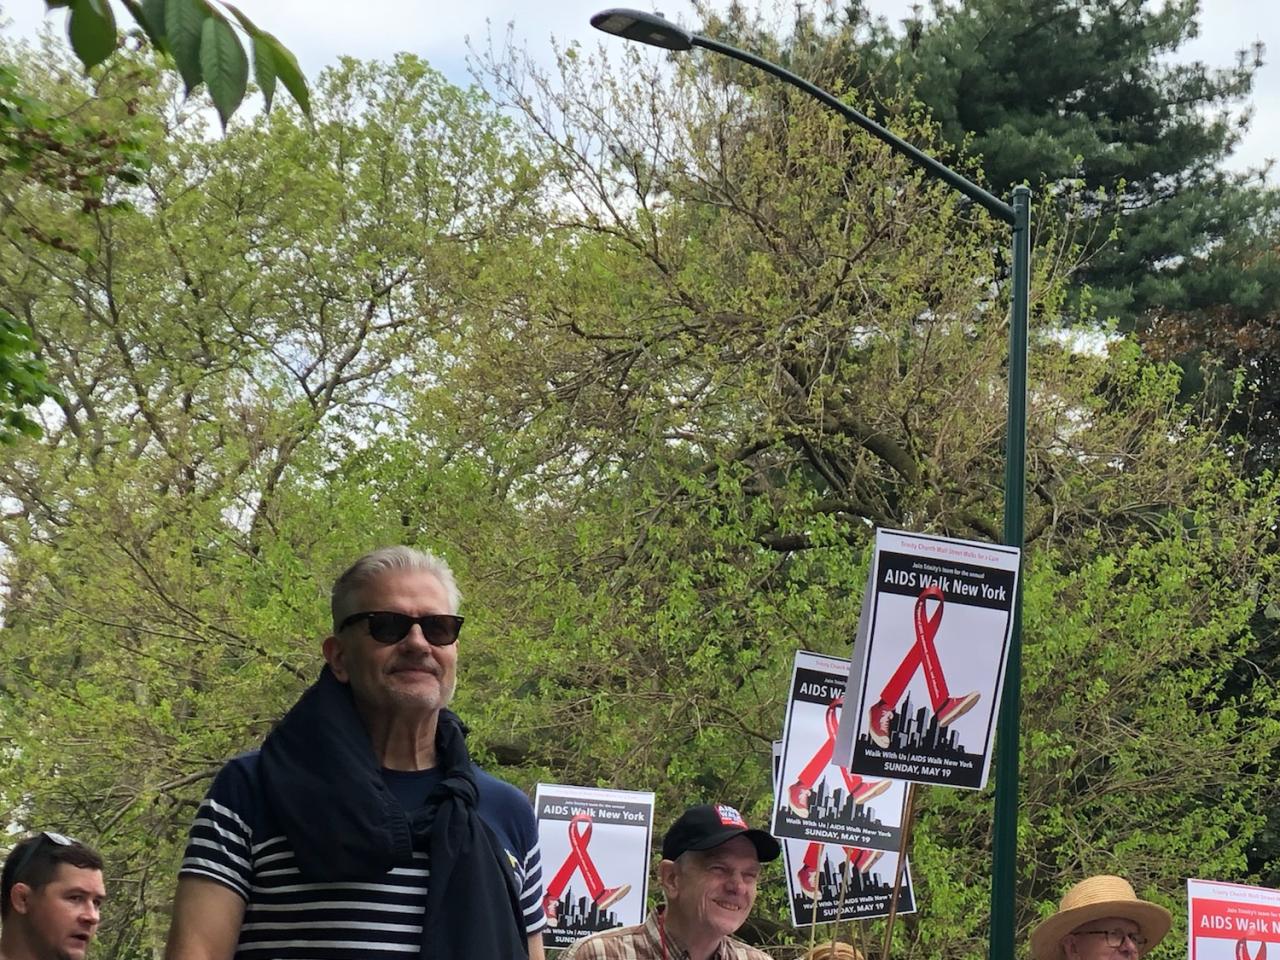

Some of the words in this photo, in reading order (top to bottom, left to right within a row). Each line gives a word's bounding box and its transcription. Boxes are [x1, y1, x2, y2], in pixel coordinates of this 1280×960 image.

[884, 569, 917, 587] AIDS
[920, 574, 950, 593] Walk
[952, 579, 979, 597] New
[981, 583, 1006, 601] York
[800, 682, 827, 697] AIDS
[865, 749, 881, 758] Walk
[882, 751, 897, 759] With
[898, 753, 907, 761] Us
[910, 755, 927, 763] AIDS
[927, 756, 943, 764] Walk
[943, 758, 958, 766] New
[959, 760, 973, 769] York
[884, 762, 920, 775] SUNDAY,
[921, 766, 941, 777] MAY
[941, 768, 951, 778] 19
[543, 805, 569, 815] AIDS
[571, 807, 596, 817] Walk
[598, 810, 621, 819] New
[622, 812, 645, 821] York
[805, 828, 840, 840] SUNDAY,
[841, 832, 860, 842] MAY
[861, 835, 871, 843] 19
[830, 823, 845, 831] AIDS
[846, 825, 862, 833] Walk
[878, 830, 892, 838] York
[823, 907, 856, 916] SUNDAY,
[857, 904, 874, 912] MAY
[1200, 915, 1233, 930] AIDS
[1236, 918, 1269, 933] Walk
